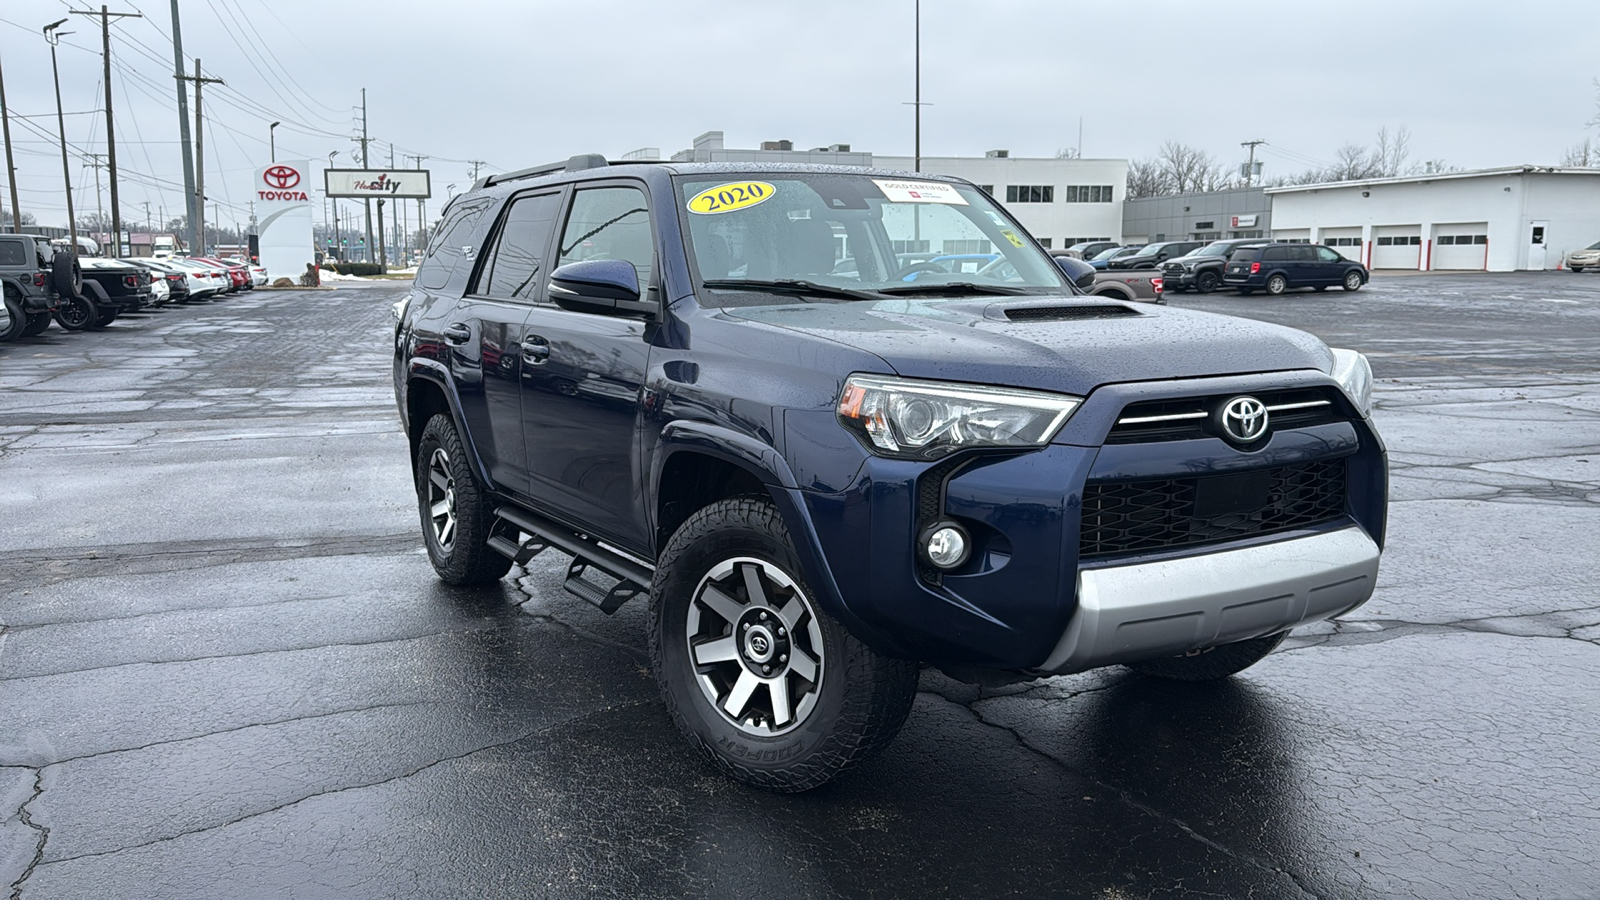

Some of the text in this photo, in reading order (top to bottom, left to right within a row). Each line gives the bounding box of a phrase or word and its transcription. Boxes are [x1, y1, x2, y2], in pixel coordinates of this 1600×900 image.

[257, 191, 308, 201] TOYOTA
[909, 184, 950, 192] CERTIFIED
[701, 184, 765, 211] 2020
[718, 735, 804, 761] COOPER
